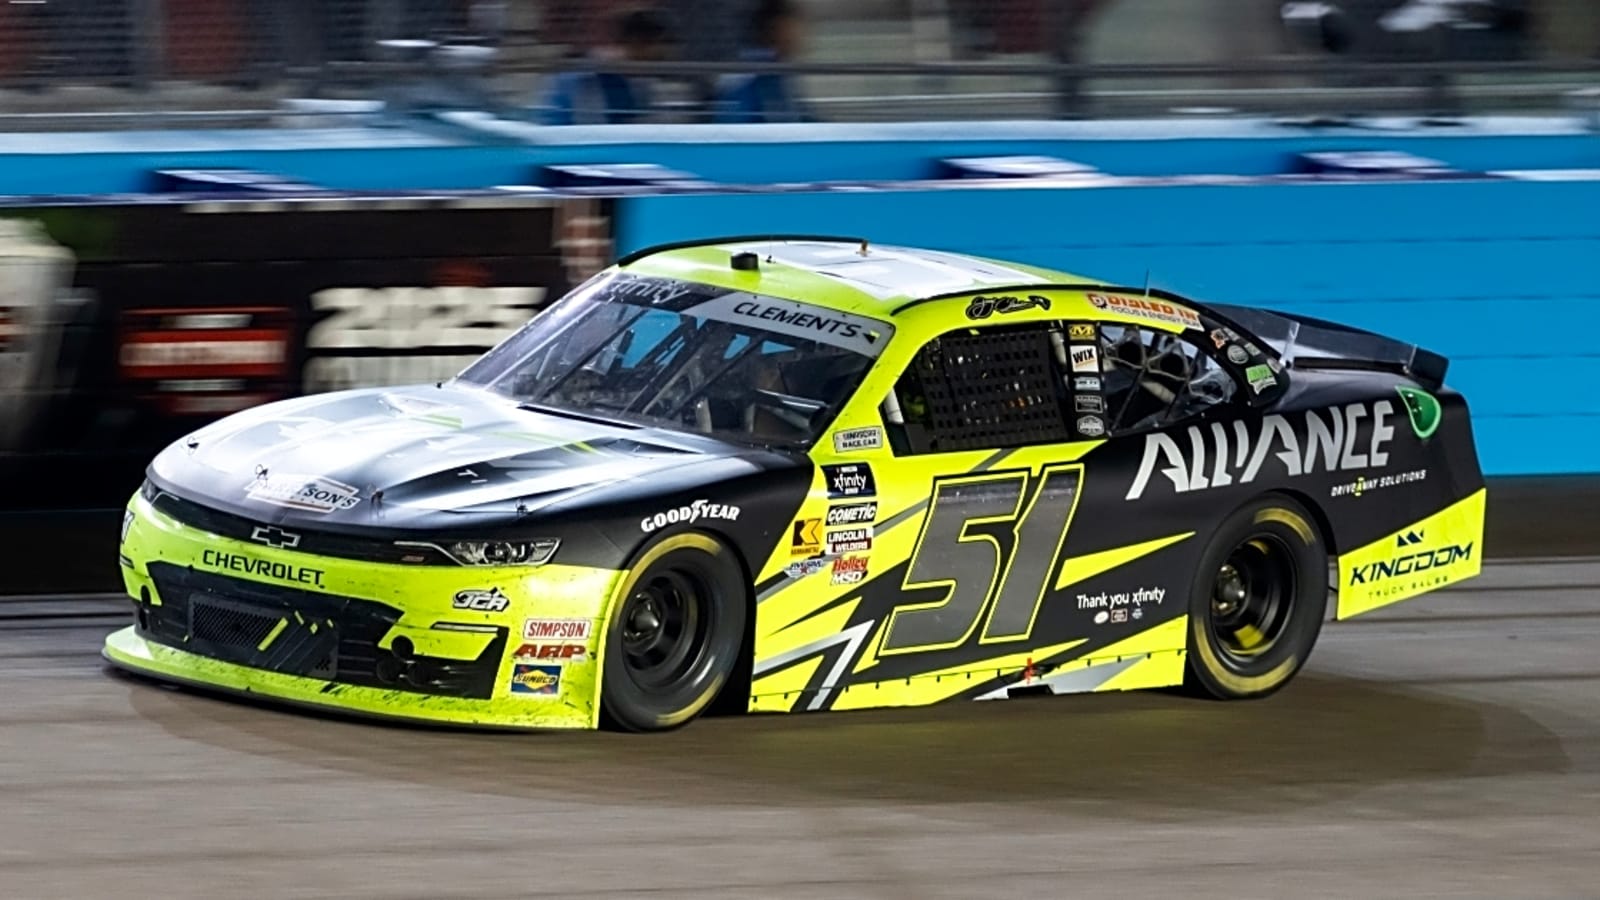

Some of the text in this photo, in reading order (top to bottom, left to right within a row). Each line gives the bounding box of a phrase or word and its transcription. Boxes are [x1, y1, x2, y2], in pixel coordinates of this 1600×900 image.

[732, 301, 861, 338] CLEMENTS
[1073, 348, 1094, 363] WIX
[1125, 400, 1394, 500] ALLIANCE
[833, 474, 867, 491] xfinity
[1379, 469, 1427, 488] SOLUTIONS
[641, 499, 740, 532] GOODYEAR
[828, 504, 876, 522] COMETIC
[829, 531, 865, 543] LINCOLN
[835, 541, 868, 552] WELDERS
[832, 556, 869, 571] Holley
[878, 462, 1085, 657] 51
[1350, 541, 1473, 586] KINGDOM
[202, 549, 325, 589] CHEVROLET
[831, 571, 864, 585] MSD
[1076, 586, 1166, 609] Thank you xfinity
[1368, 586, 1404, 599] TRUCK
[527, 620, 586, 638] SIMPSON
[511, 643, 586, 659] ARP
[514, 673, 558, 684] SUNOCO
